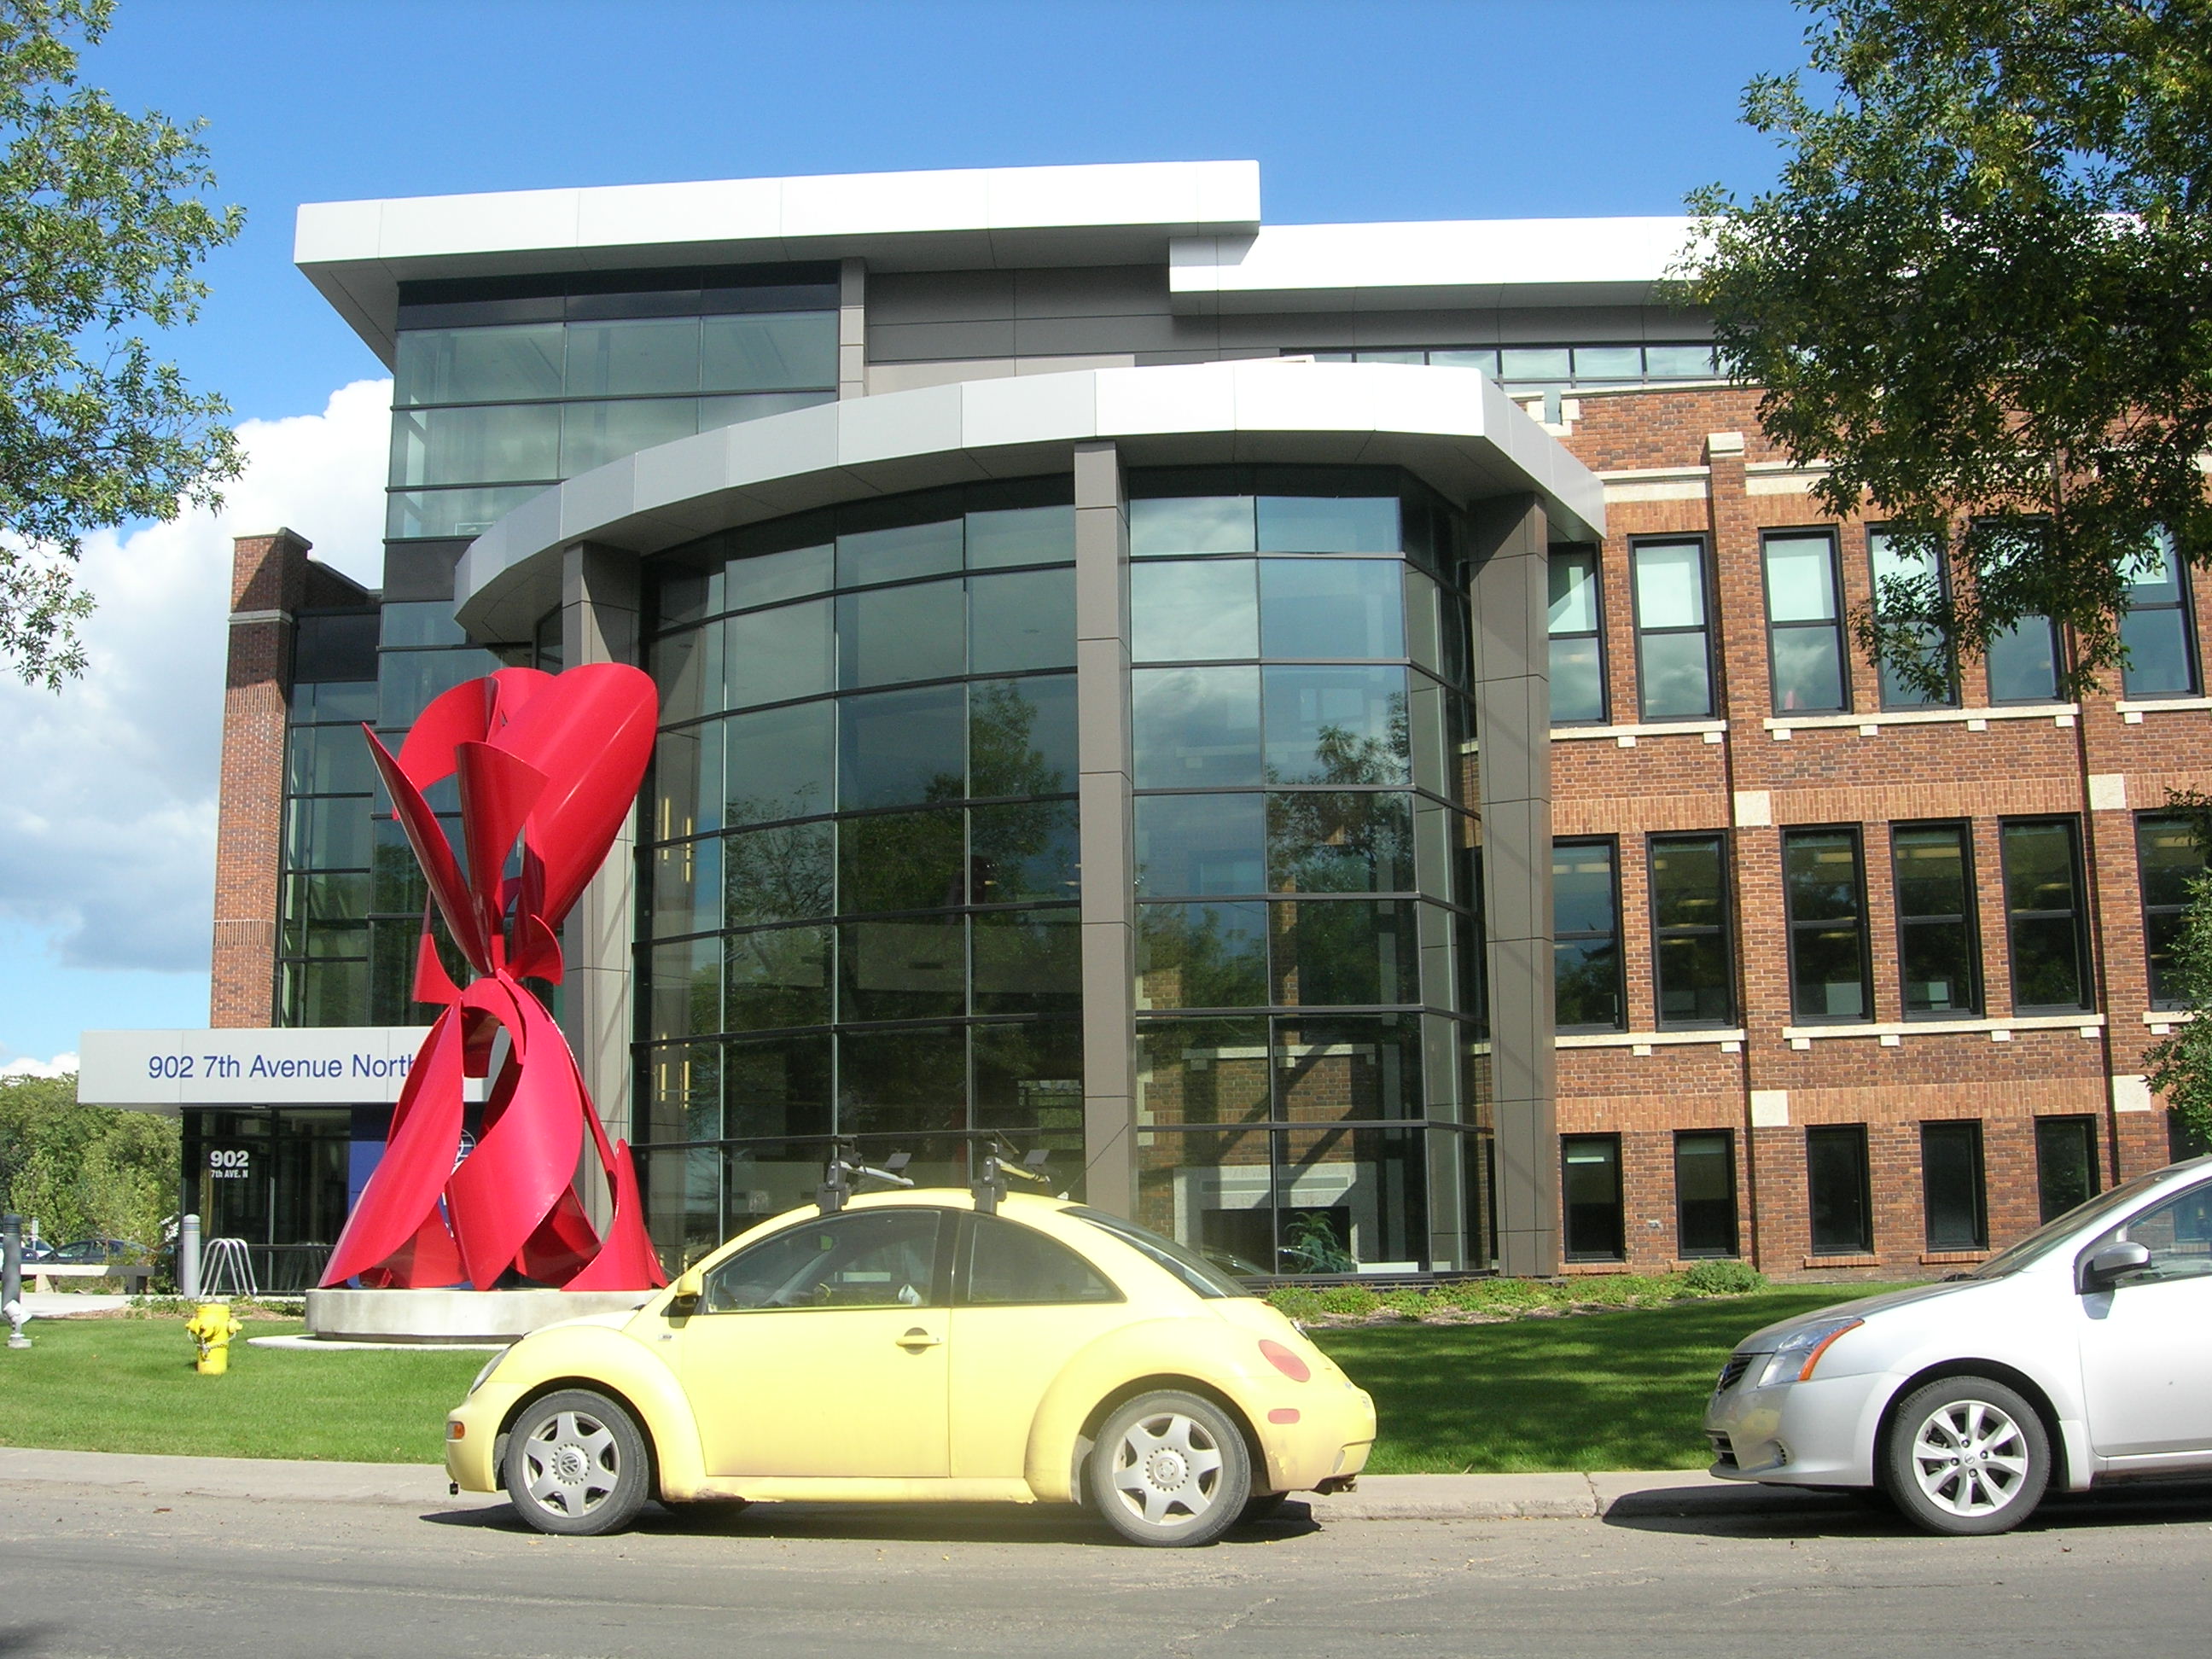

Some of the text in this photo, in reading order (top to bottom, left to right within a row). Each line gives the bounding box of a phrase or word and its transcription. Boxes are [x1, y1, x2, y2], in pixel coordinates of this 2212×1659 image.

[148, 1055, 194, 1079] 902
[203, 1054, 241, 1079] 7th
[248, 1054, 343, 1079] Avenue
[210, 1150, 249, 1167] 902
[242, 1169, 249, 1179] N
